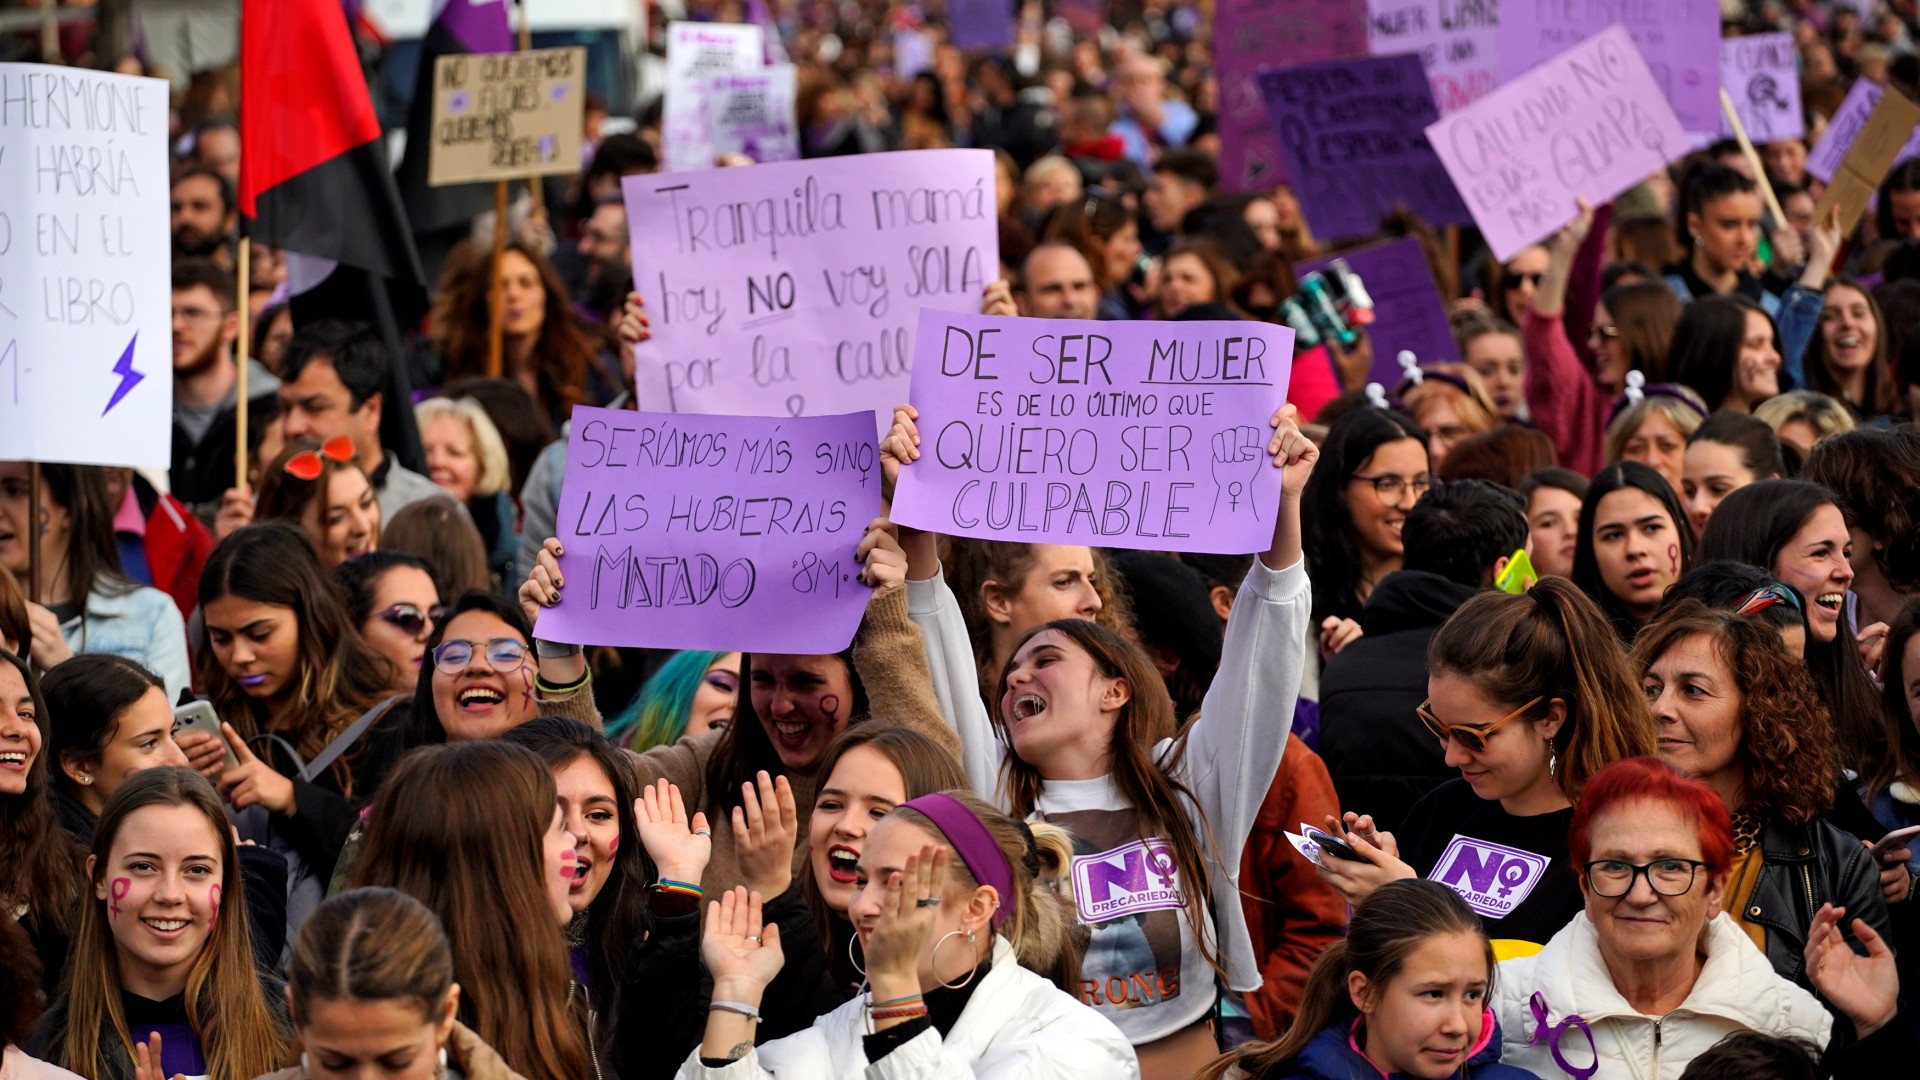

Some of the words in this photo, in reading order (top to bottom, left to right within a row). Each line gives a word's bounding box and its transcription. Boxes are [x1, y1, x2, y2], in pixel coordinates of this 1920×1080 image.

[441, 55, 469, 89] NO
[1568, 37, 1629, 96] NO
[2, 72, 149, 136] HERMIONE
[36, 138, 140, 196] HABRÍA
[1550, 95, 1655, 191] GUAPA
[872, 177, 985, 231] mamá
[37, 212, 80, 257] EN
[100, 214, 134, 257] EL
[43, 275, 136, 326] LIBRO
[659, 270, 727, 336] hoy
[746, 271, 797, 316] NO
[823, 264, 890, 320] voy
[904, 245, 984, 298] SOLA
[665, 356, 721, 414] por
[749, 333, 798, 388] la
[835, 326, 914, 386] call
[941, 325, 1001, 381] DE
[1029, 334, 1113, 386] SER
[1147, 336, 1267, 382] MUJER
[976, 391, 1004, 417] ES
[1016, 394, 1041, 418] DE
[1050, 394, 1075, 418] LO
[1087, 390, 1158, 418] ÚLTIMO
[1168, 392, 1215, 417] QUE
[735, 425, 793, 475] MÁS
[935, 419, 1098, 476] QUIERO
[1120, 424, 1193, 472] SER
[575, 491, 649, 536] LAS
[666, 495, 846, 536] HUBIERAIS
[952, 479, 1195, 538] CULPABLE
[590, 543, 756, 610] MATADO
